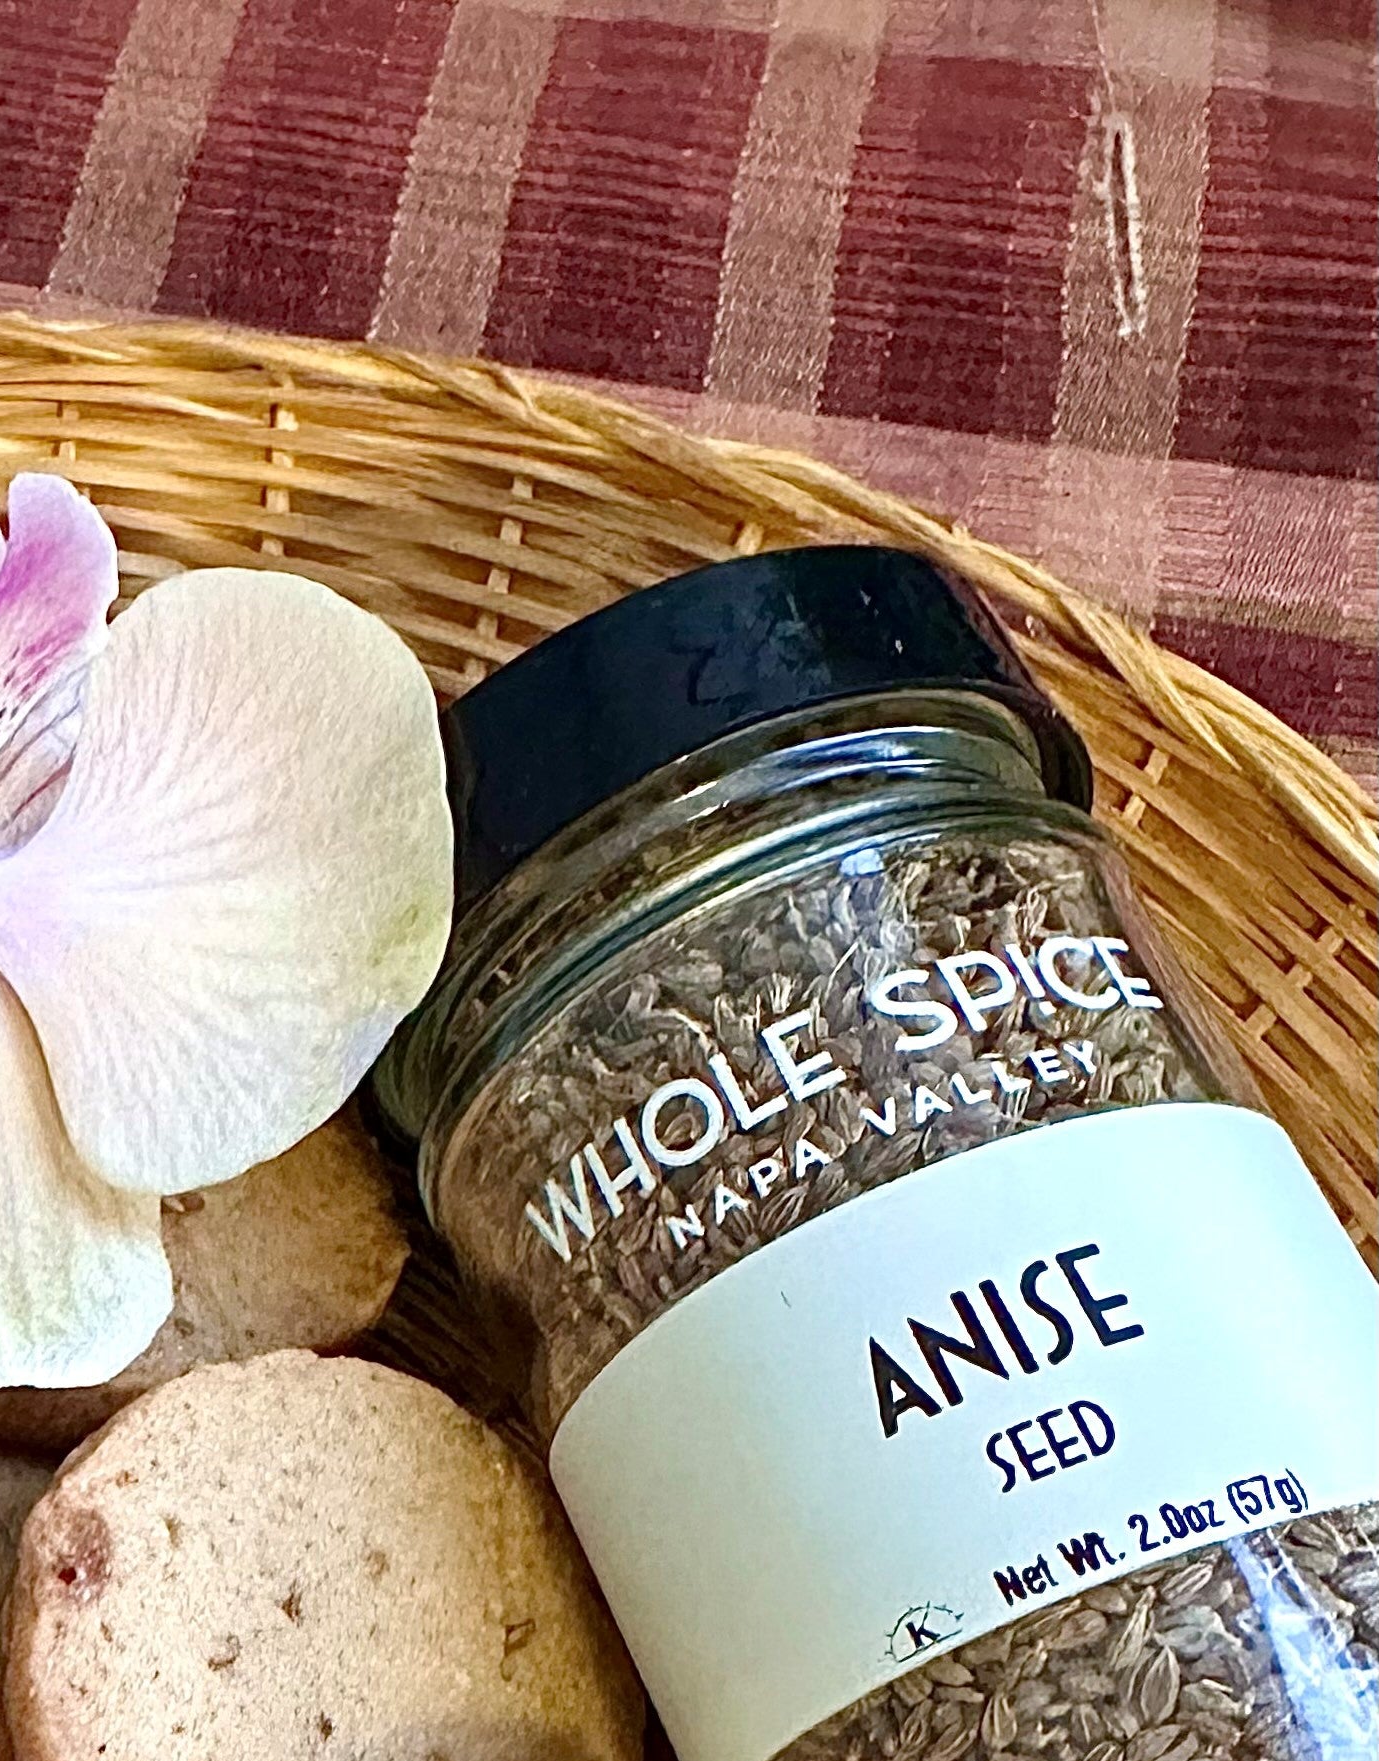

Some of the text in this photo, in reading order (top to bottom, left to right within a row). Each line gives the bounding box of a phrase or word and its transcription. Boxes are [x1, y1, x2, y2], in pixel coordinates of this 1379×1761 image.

[525, 936, 1163, 1263] WHOLE SPICE
[665, 1040, 1097, 1249] NAPA VALLEY
[869, 1243, 1145, 1438] ANISE
[986, 1400, 1116, 1493] SEED
[993, 1468, 1309, 1607] Net Wt. 2.0oz (57g)
